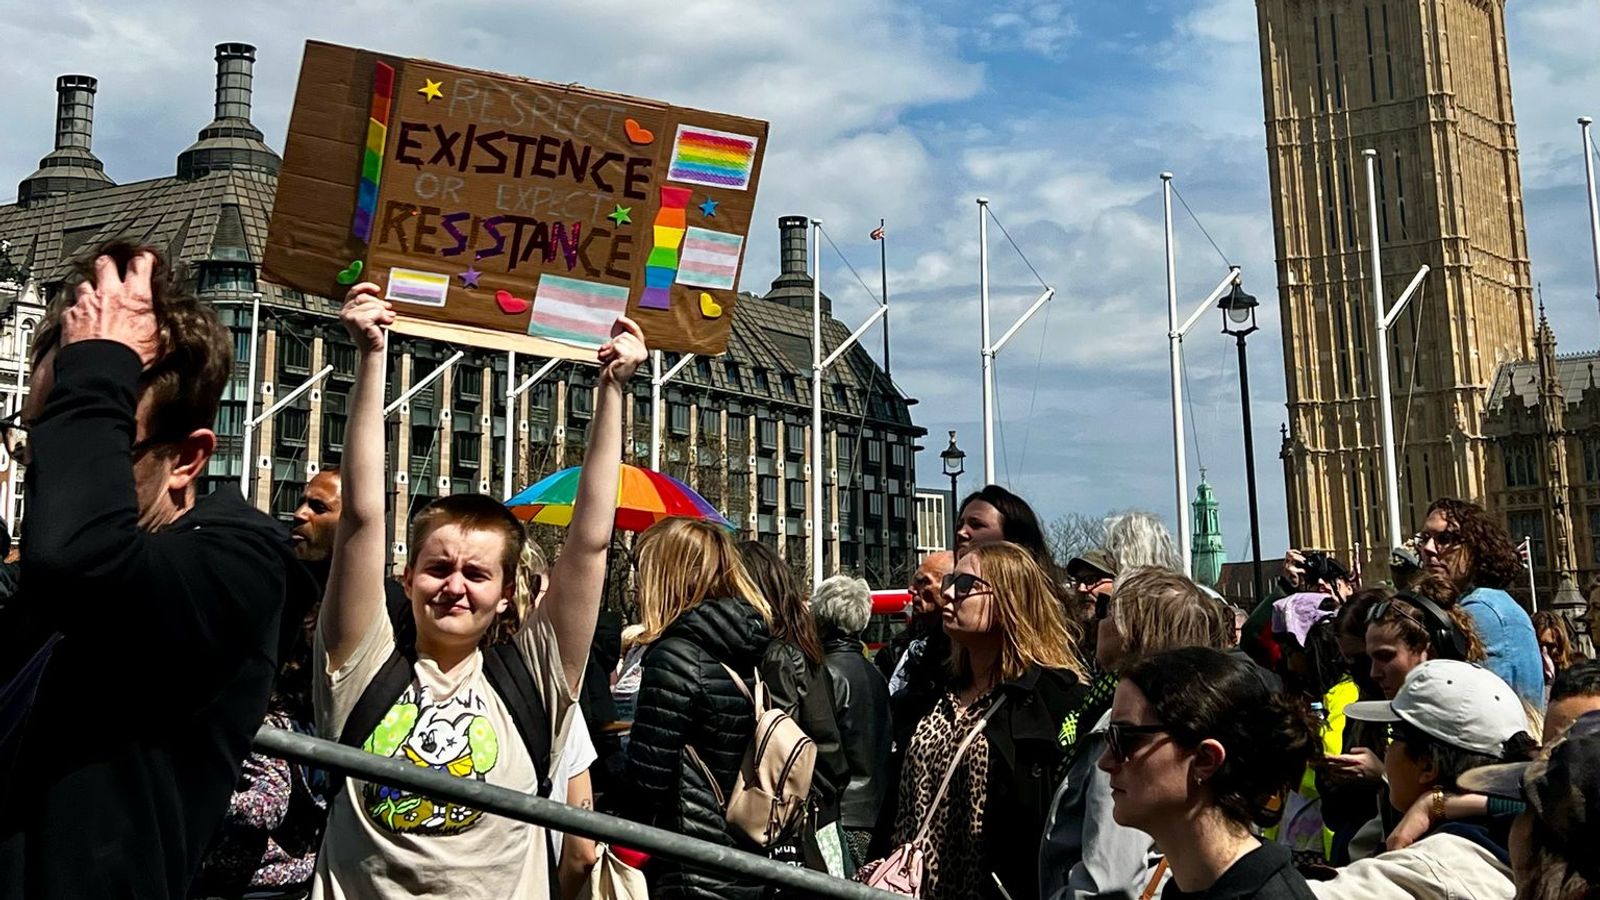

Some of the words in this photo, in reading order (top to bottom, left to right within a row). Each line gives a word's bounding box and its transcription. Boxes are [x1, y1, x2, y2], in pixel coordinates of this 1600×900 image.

[449, 79, 626, 142] RESPECT
[396, 122, 652, 199] EXISTENCE
[415, 172, 464, 202] OR
[496, 184, 611, 224] EXPECT
[379, 201, 632, 281] RESISTANCE
